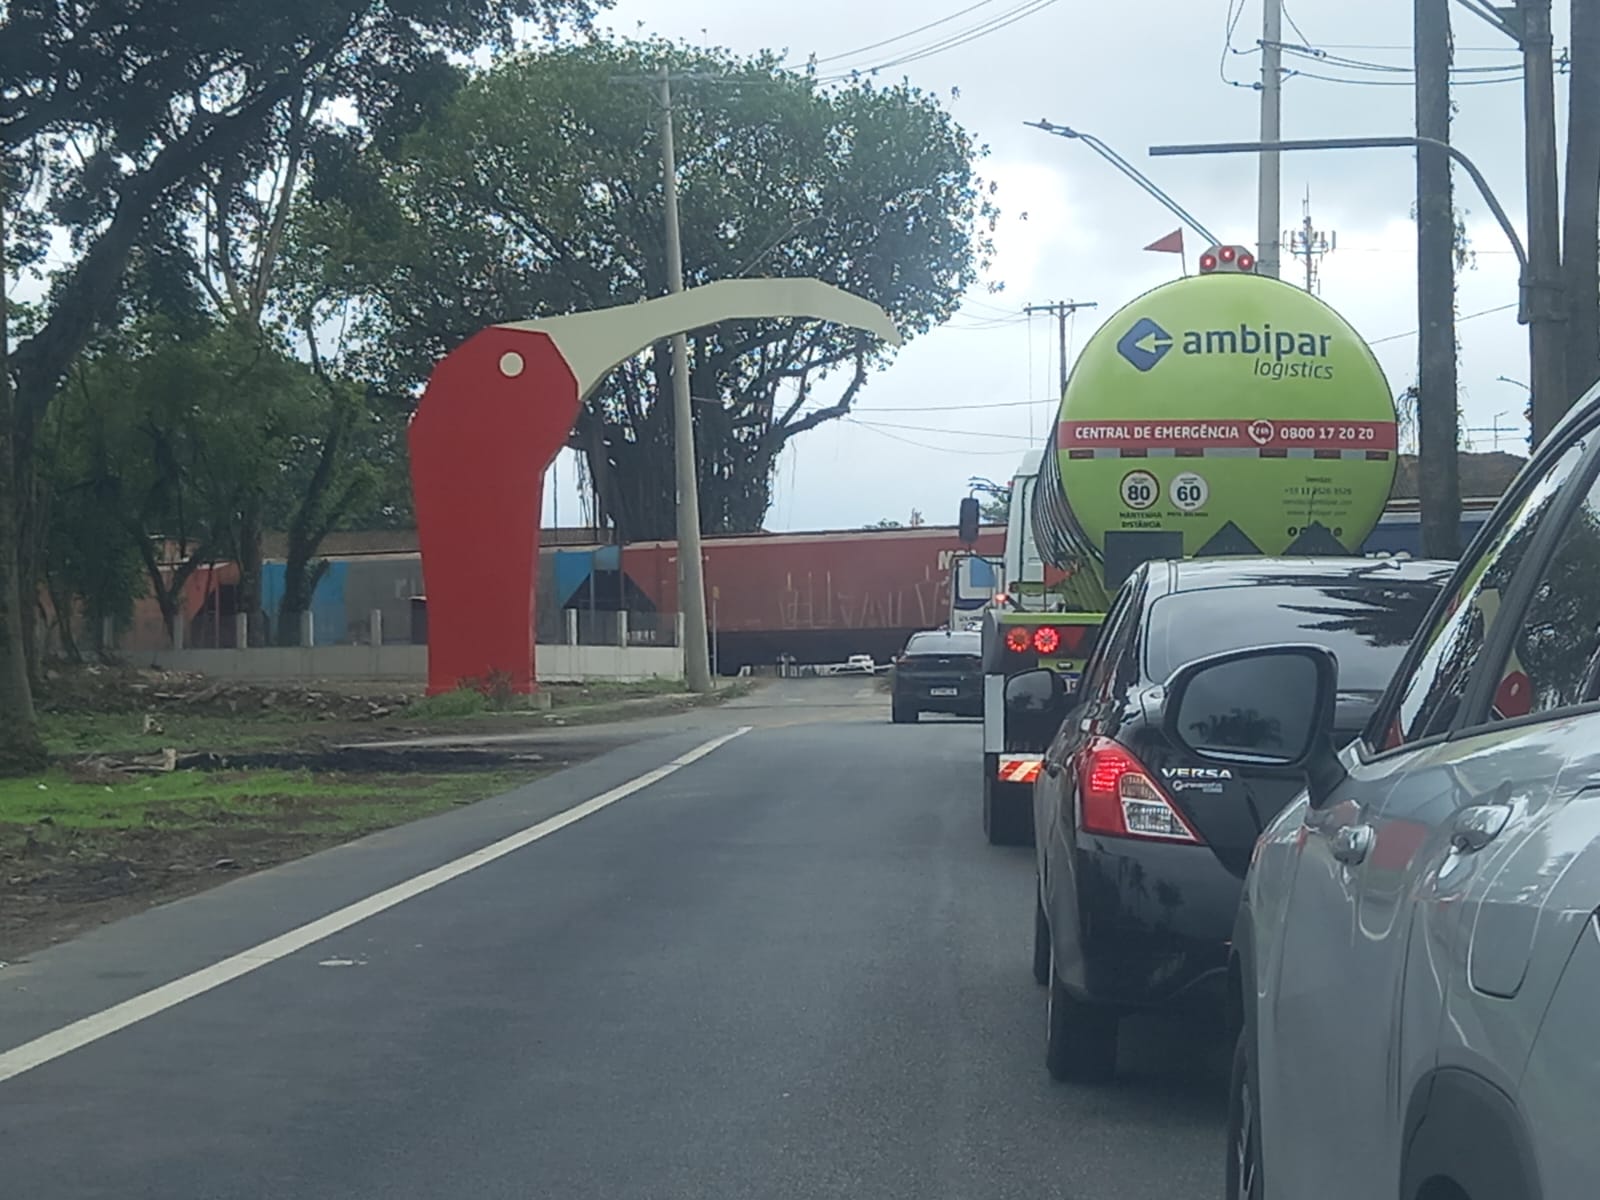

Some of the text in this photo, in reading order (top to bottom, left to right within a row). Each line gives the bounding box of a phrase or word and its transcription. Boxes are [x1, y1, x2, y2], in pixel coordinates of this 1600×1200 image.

[1183, 324, 1331, 361] ambipar
[1254, 358, 1334, 380] logistics
[1075, 424, 1240, 439] CENTRAL DE EMERGÊNCIA
[1280, 427, 1375, 440] 0800 17 20 20
[1127, 485, 1150, 501] 80
[1177, 485, 1201, 502] 60
[1161, 767, 1232, 779] VERSA
